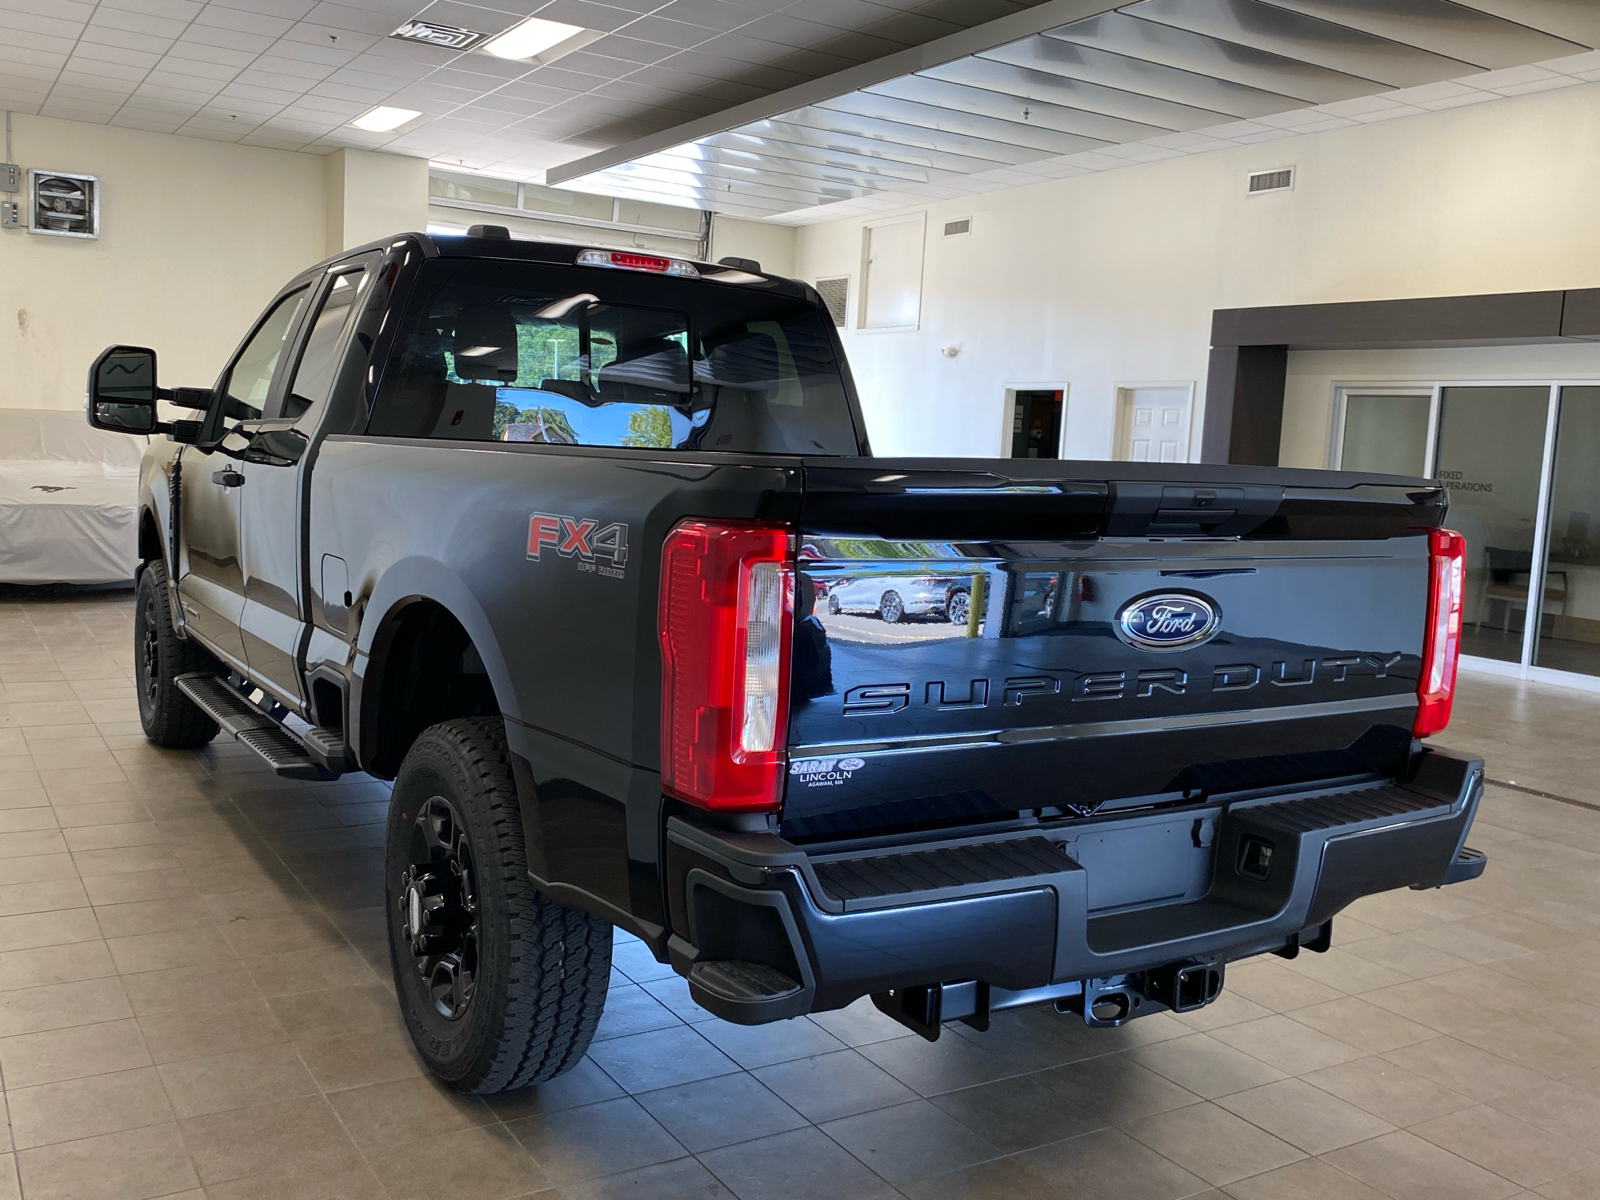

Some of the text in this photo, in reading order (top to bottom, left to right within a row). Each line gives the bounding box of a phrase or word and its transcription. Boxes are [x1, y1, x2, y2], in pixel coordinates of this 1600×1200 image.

[1439, 470, 1463, 480] FIXED
[1443, 481, 1493, 492] PERATIONS
[526, 511, 629, 568] FX4
[577, 562, 596, 573] OFF
[1146, 605, 1197, 634] Ford
[843, 651, 1402, 717] SUPER DUTY
[789, 760, 838, 775] SARAT
[800, 771, 852, 782] LINCOLN
